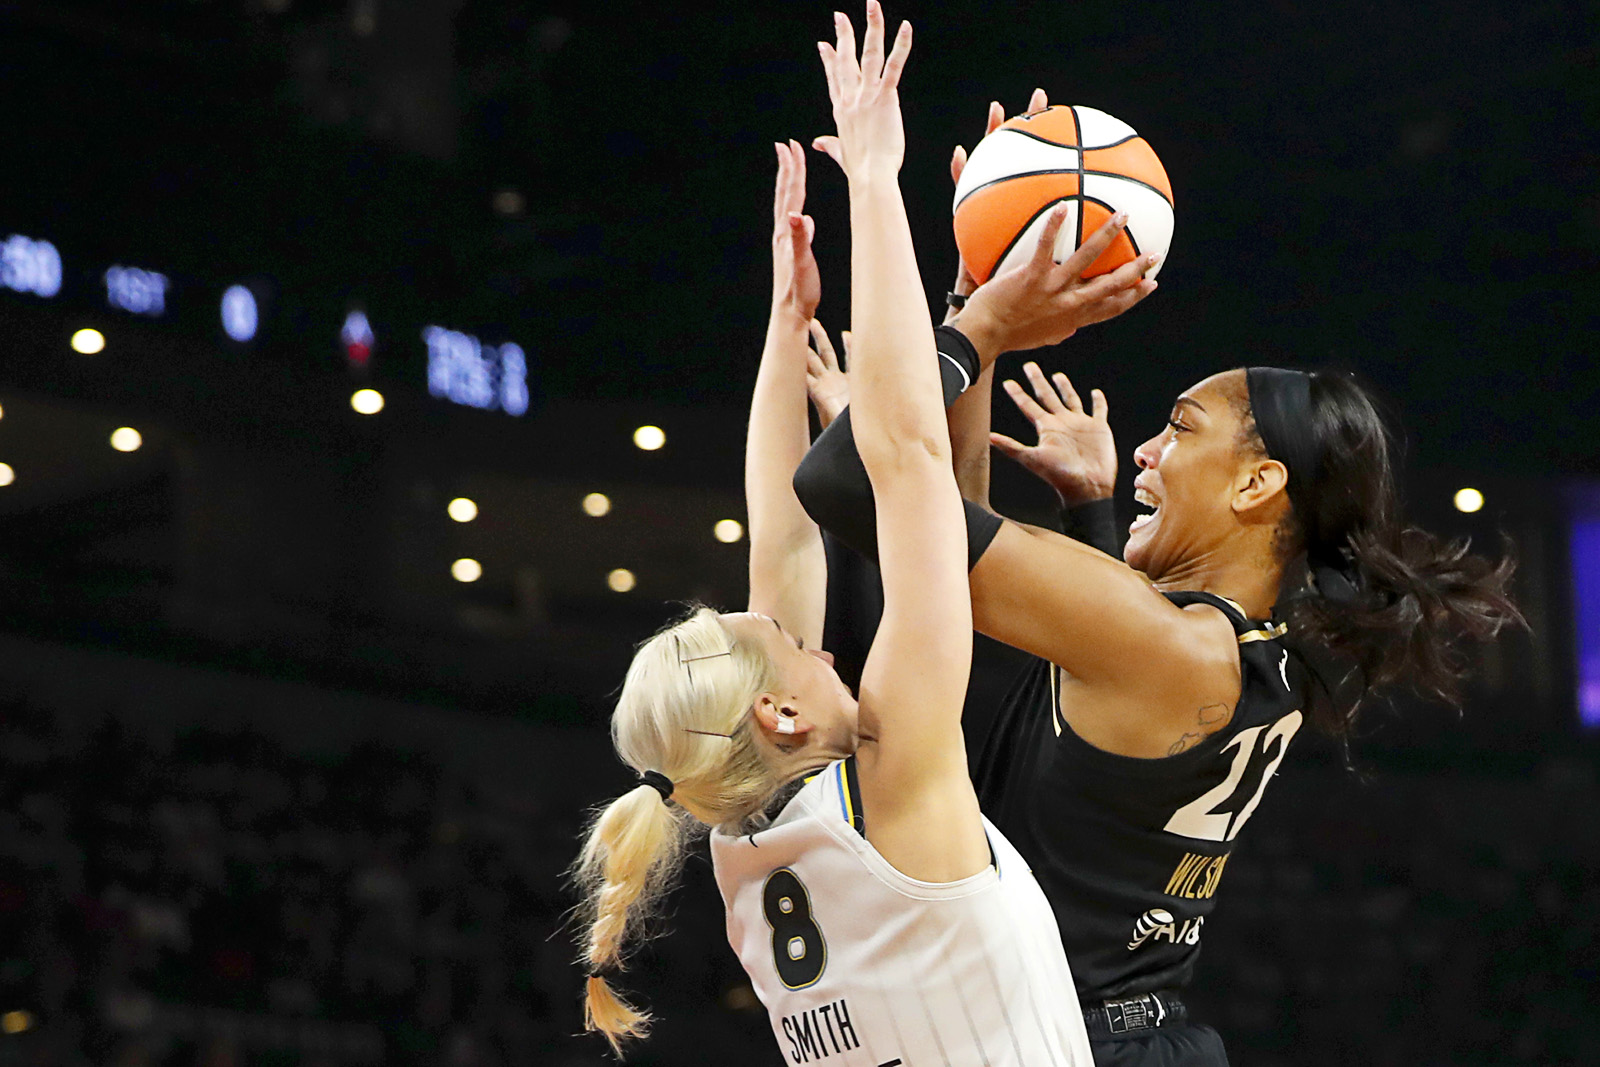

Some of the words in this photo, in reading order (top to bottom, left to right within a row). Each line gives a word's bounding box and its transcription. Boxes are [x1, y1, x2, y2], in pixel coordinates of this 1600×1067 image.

[1164, 852, 1231, 899] WILSO
[761, 866, 827, 992] 8
[782, 999, 860, 1065] SMITH
